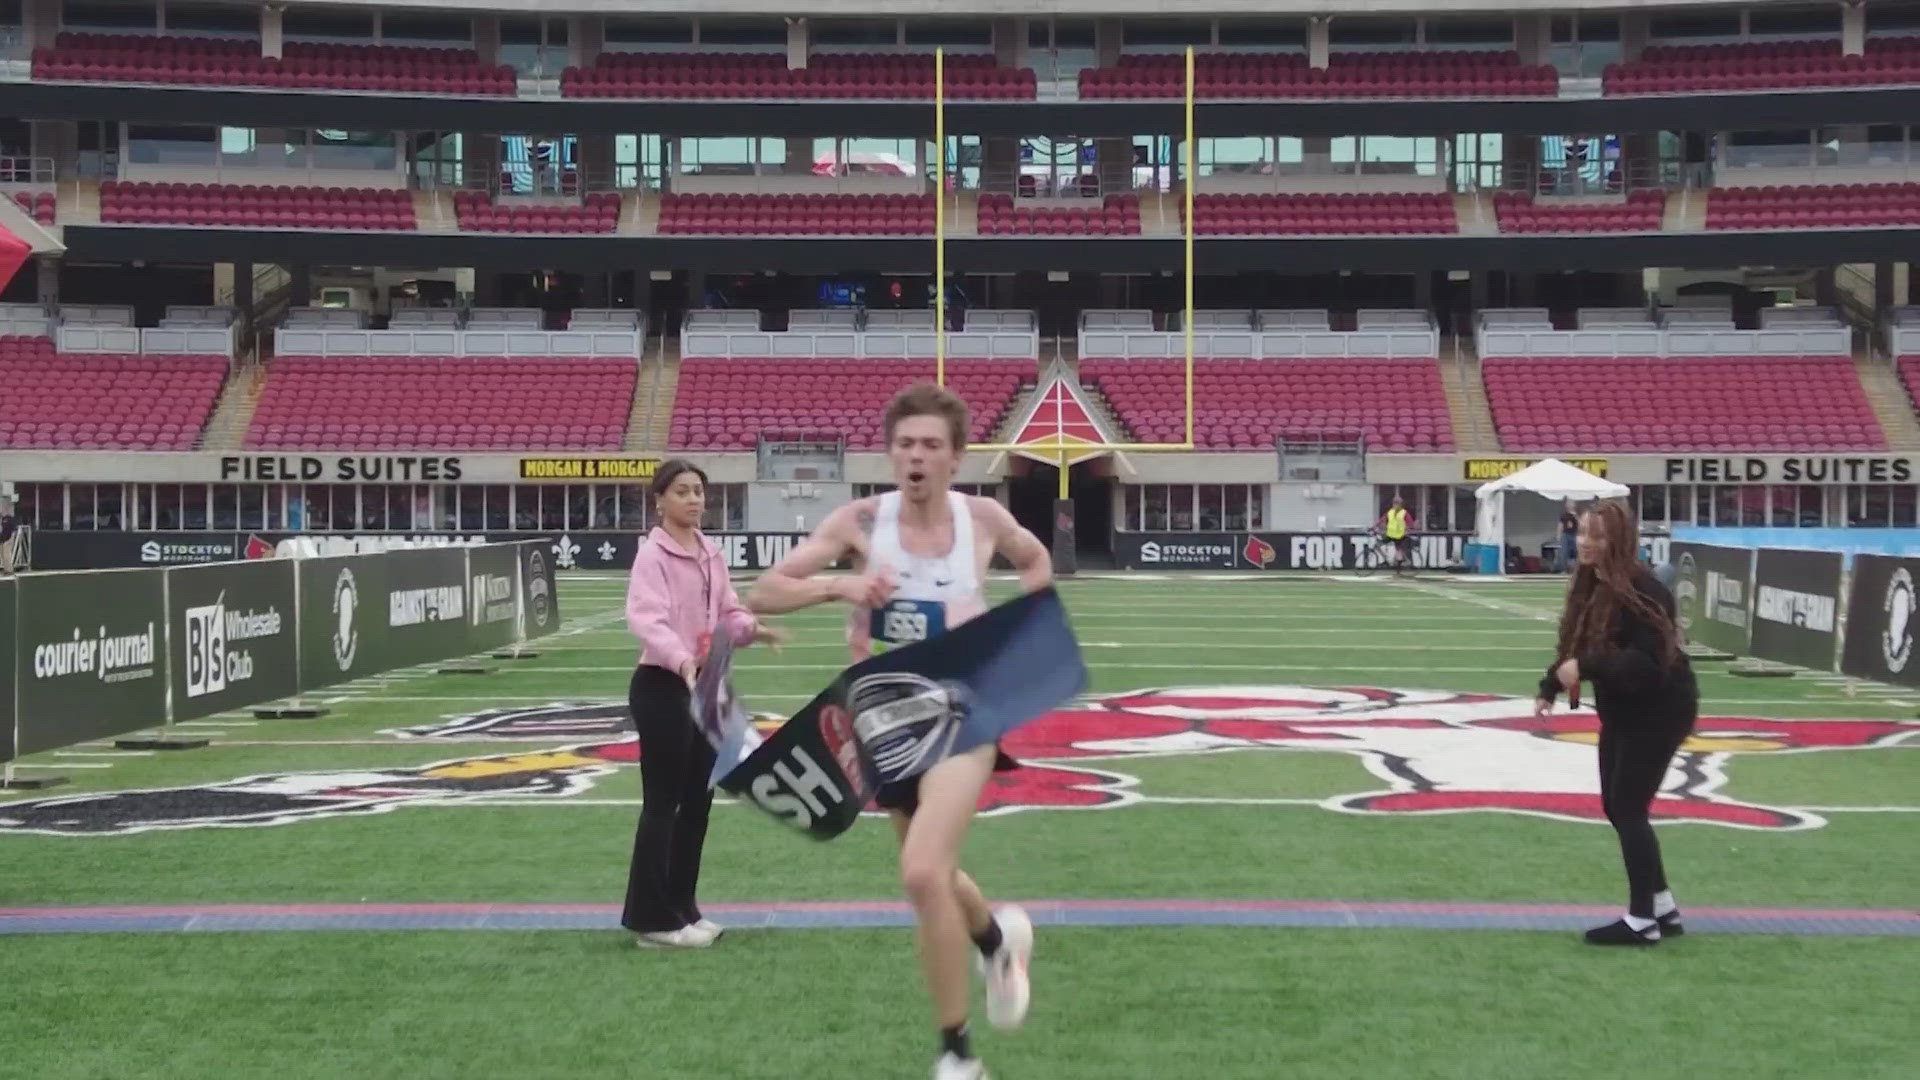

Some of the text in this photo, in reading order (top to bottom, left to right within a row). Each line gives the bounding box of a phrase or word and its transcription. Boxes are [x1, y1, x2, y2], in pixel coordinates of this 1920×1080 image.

[222, 457, 462, 480] FIELD SUITES
[525, 460, 582, 477] MORGAN
[584, 460, 596, 477] &
[1665, 458, 1911, 481] FIELD SUITES
[162, 545, 232, 554] STOCKTON
[1163, 545, 1231, 555] STOCKTON
[1291, 536, 1343, 568] FOR
[225, 605, 281, 641] Wholesale
[35, 621, 154, 680] courier journal
[227, 649, 254, 682] Club
